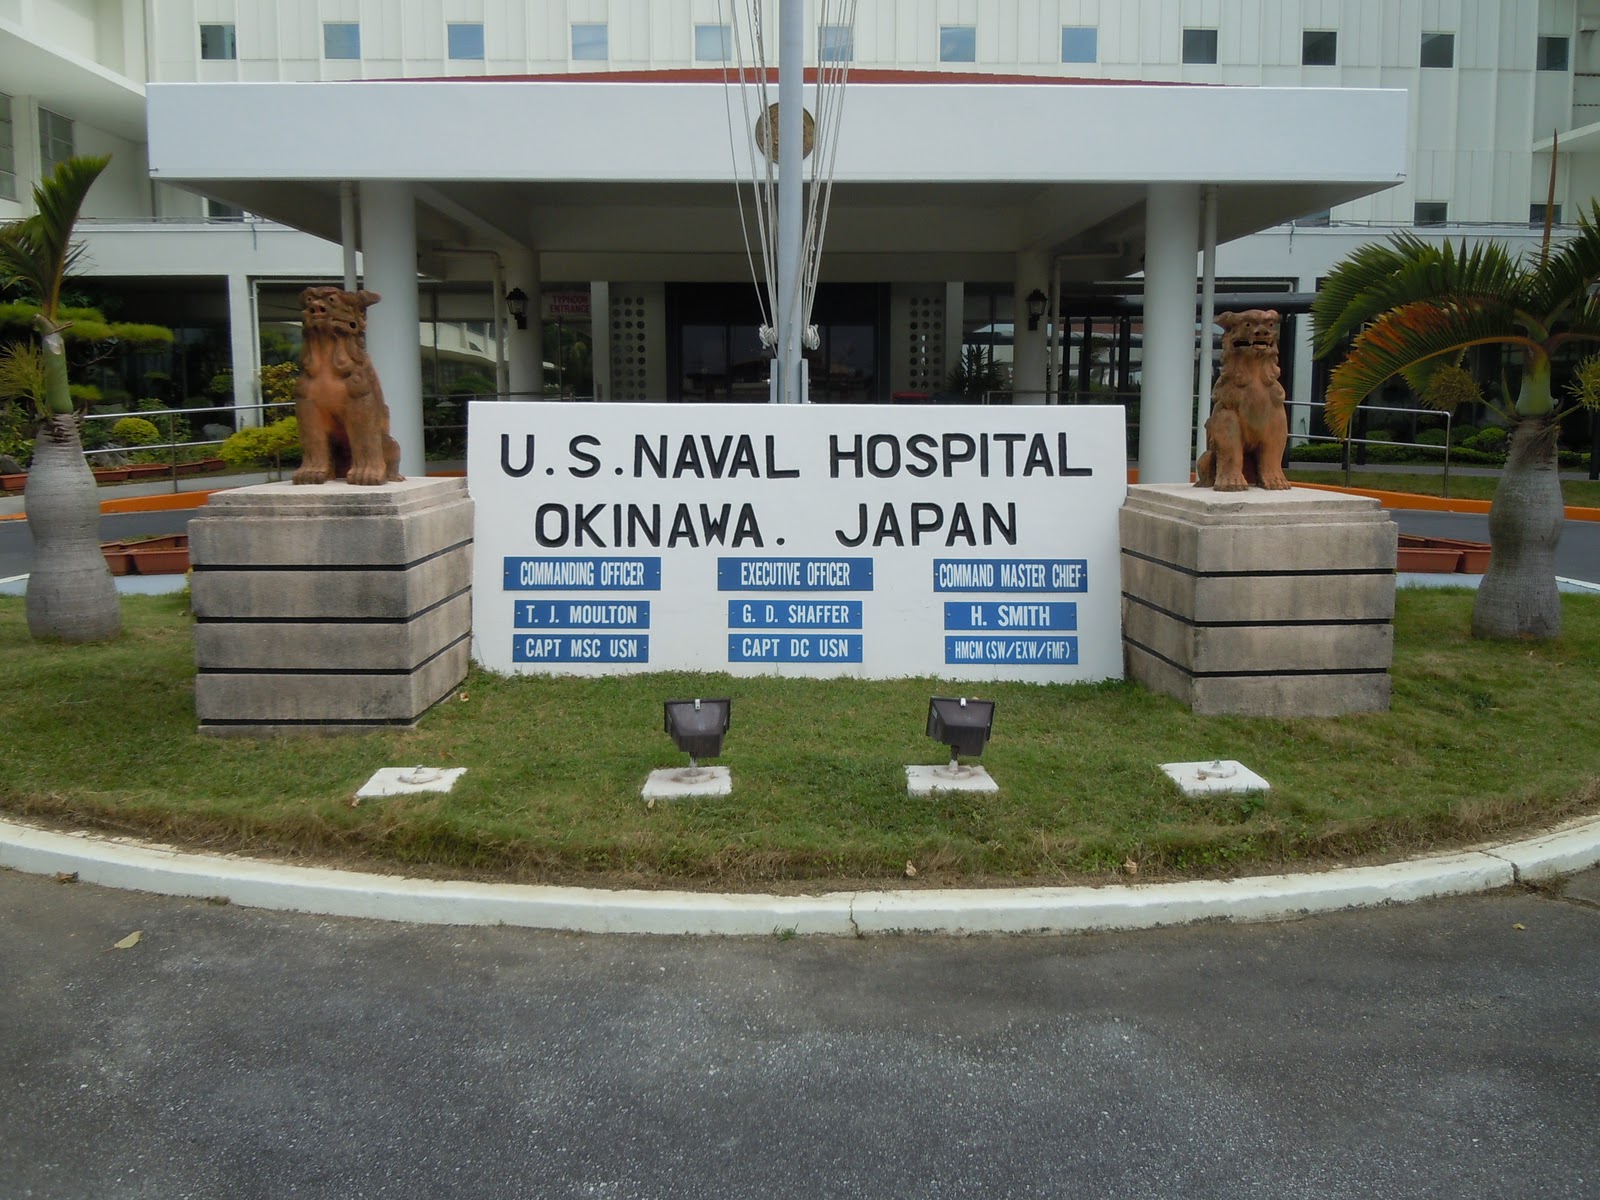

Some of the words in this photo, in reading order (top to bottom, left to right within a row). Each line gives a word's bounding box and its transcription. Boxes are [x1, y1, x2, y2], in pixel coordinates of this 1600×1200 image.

[550, 304, 590, 313] ENTRANCE
[829, 431, 1093, 479] HOSPITAL
[835, 501, 1017, 548] JAPAN
[520, 561, 594, 586] COMMANDING
[601, 561, 644, 586] OFFICER
[741, 561, 801, 586] EXECUTIVE
[807, 561, 850, 586] OFFICER
[939, 563, 994, 588] COMMAND
[1001, 563, 1046, 588] MASTER
[1052, 563, 1082, 588] CHIEF
[526, 604, 539, 624] T.
[549, 604, 560, 624] J.
[569, 604, 637, 624] MOULTON
[742, 604, 756, 623] G.
[765, 604, 779, 623] D.
[788, 604, 849, 624] SHAFFER
[970, 605, 987, 626] H.
[997, 604, 1051, 627] SMITH
[525, 638, 562, 658] CAPT
[570, 638, 601, 658] MSC
[609, 638, 638, 658] USN
[742, 637, 780, 657] CAPT
[790, 638, 810, 658] DC
[819, 638, 848, 658] USN
[954, 640, 983, 659] HMCM
